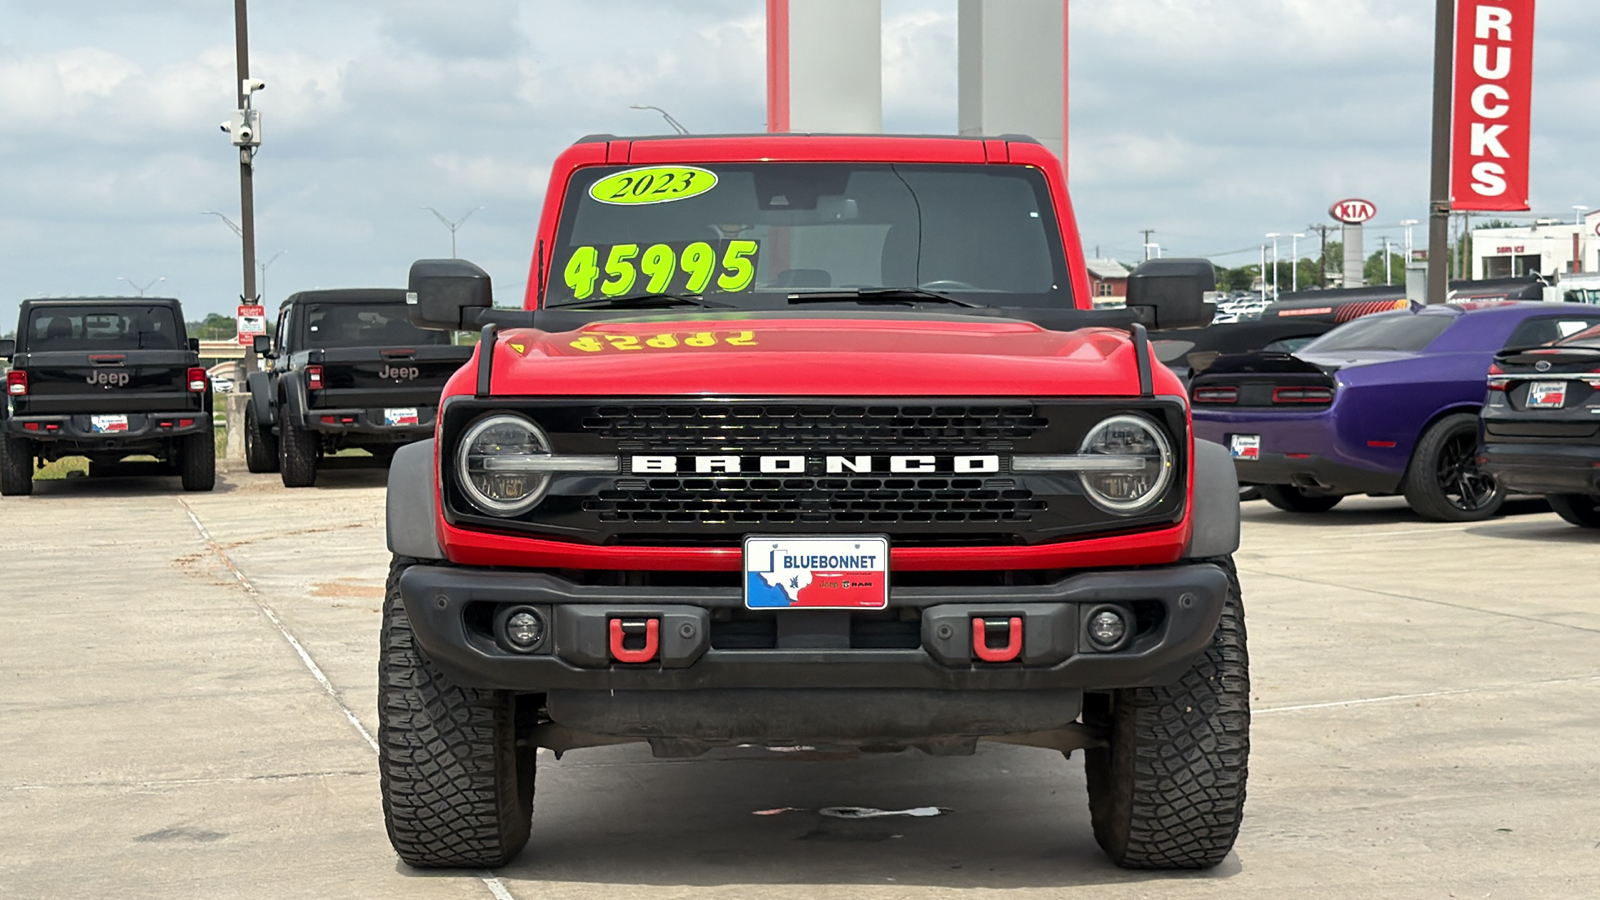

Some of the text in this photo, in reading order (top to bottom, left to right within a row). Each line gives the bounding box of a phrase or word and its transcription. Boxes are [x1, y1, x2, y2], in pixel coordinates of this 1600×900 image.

[1470, 0, 1512, 197] RUCKS
[610, 171, 696, 200] 2023
[1340, 204, 1369, 219] KIA
[564, 240, 759, 300] 45995
[86, 370, 130, 387] Jeep
[379, 364, 419, 380] Jeep
[631, 454, 1000, 474] BRONCO
[783, 555, 877, 569] BLUEBONNET
